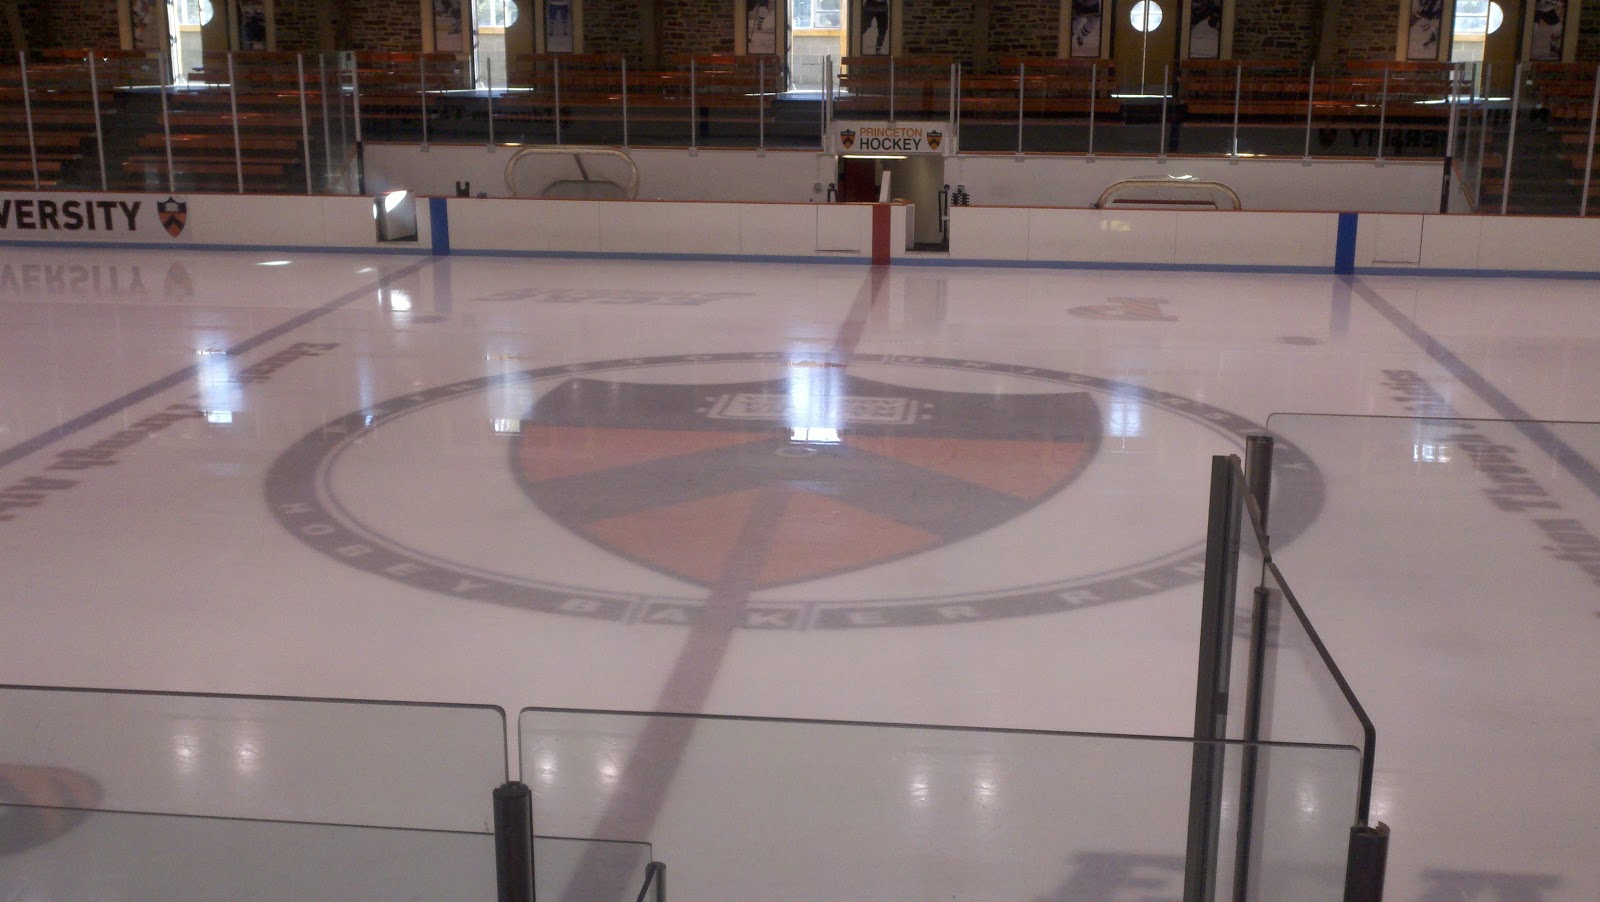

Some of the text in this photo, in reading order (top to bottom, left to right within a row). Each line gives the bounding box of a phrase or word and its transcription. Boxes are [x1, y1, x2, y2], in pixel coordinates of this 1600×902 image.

[860, 127, 923, 138] PRINCETON
[859, 137, 922, 151] HOCKEY
[277, 502, 1206, 627] HOBEY BAKER RIN
